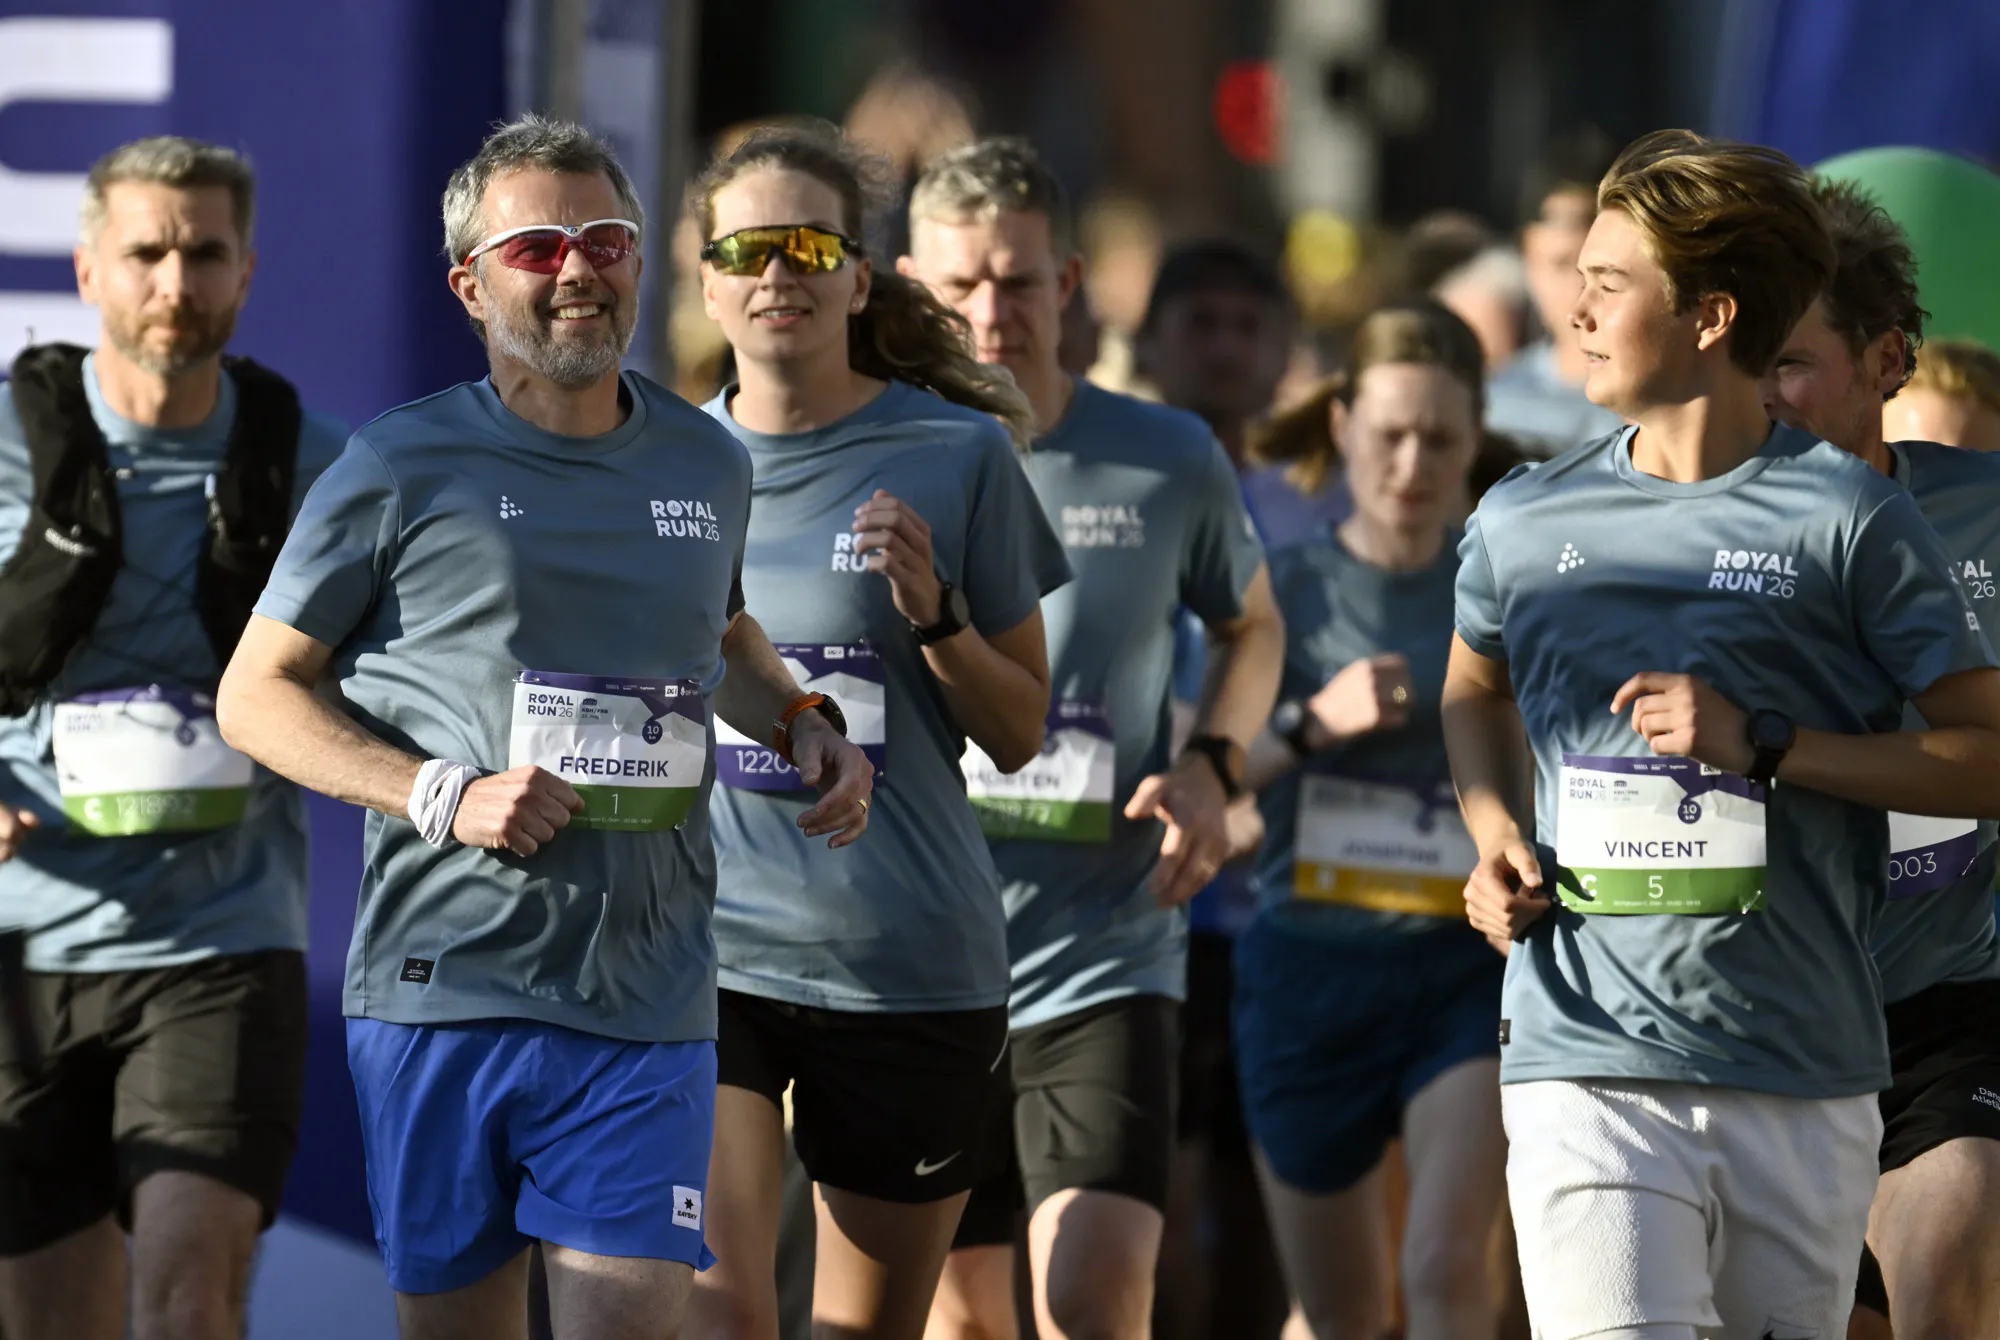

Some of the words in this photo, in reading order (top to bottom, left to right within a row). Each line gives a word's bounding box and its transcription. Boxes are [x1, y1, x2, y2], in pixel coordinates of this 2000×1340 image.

[650, 499, 717, 521] ROYAL
[1713, 549, 1799, 577] ROYAL
[528, 693, 574, 706] ROYAL
[647, 725, 660, 735] 10
[559, 756, 669, 778] FREDERIK
[735, 750, 801, 774] 1220
[1569, 777, 1606, 789] ROYAL
[84, 797, 102, 820] C
[611, 793, 619, 814] 1
[1682, 804, 1697, 815] 10
[1604, 840, 1709, 859] VINCENT
[1647, 875, 1664, 899] 5
[677, 1210, 698, 1221] SAYSKY
